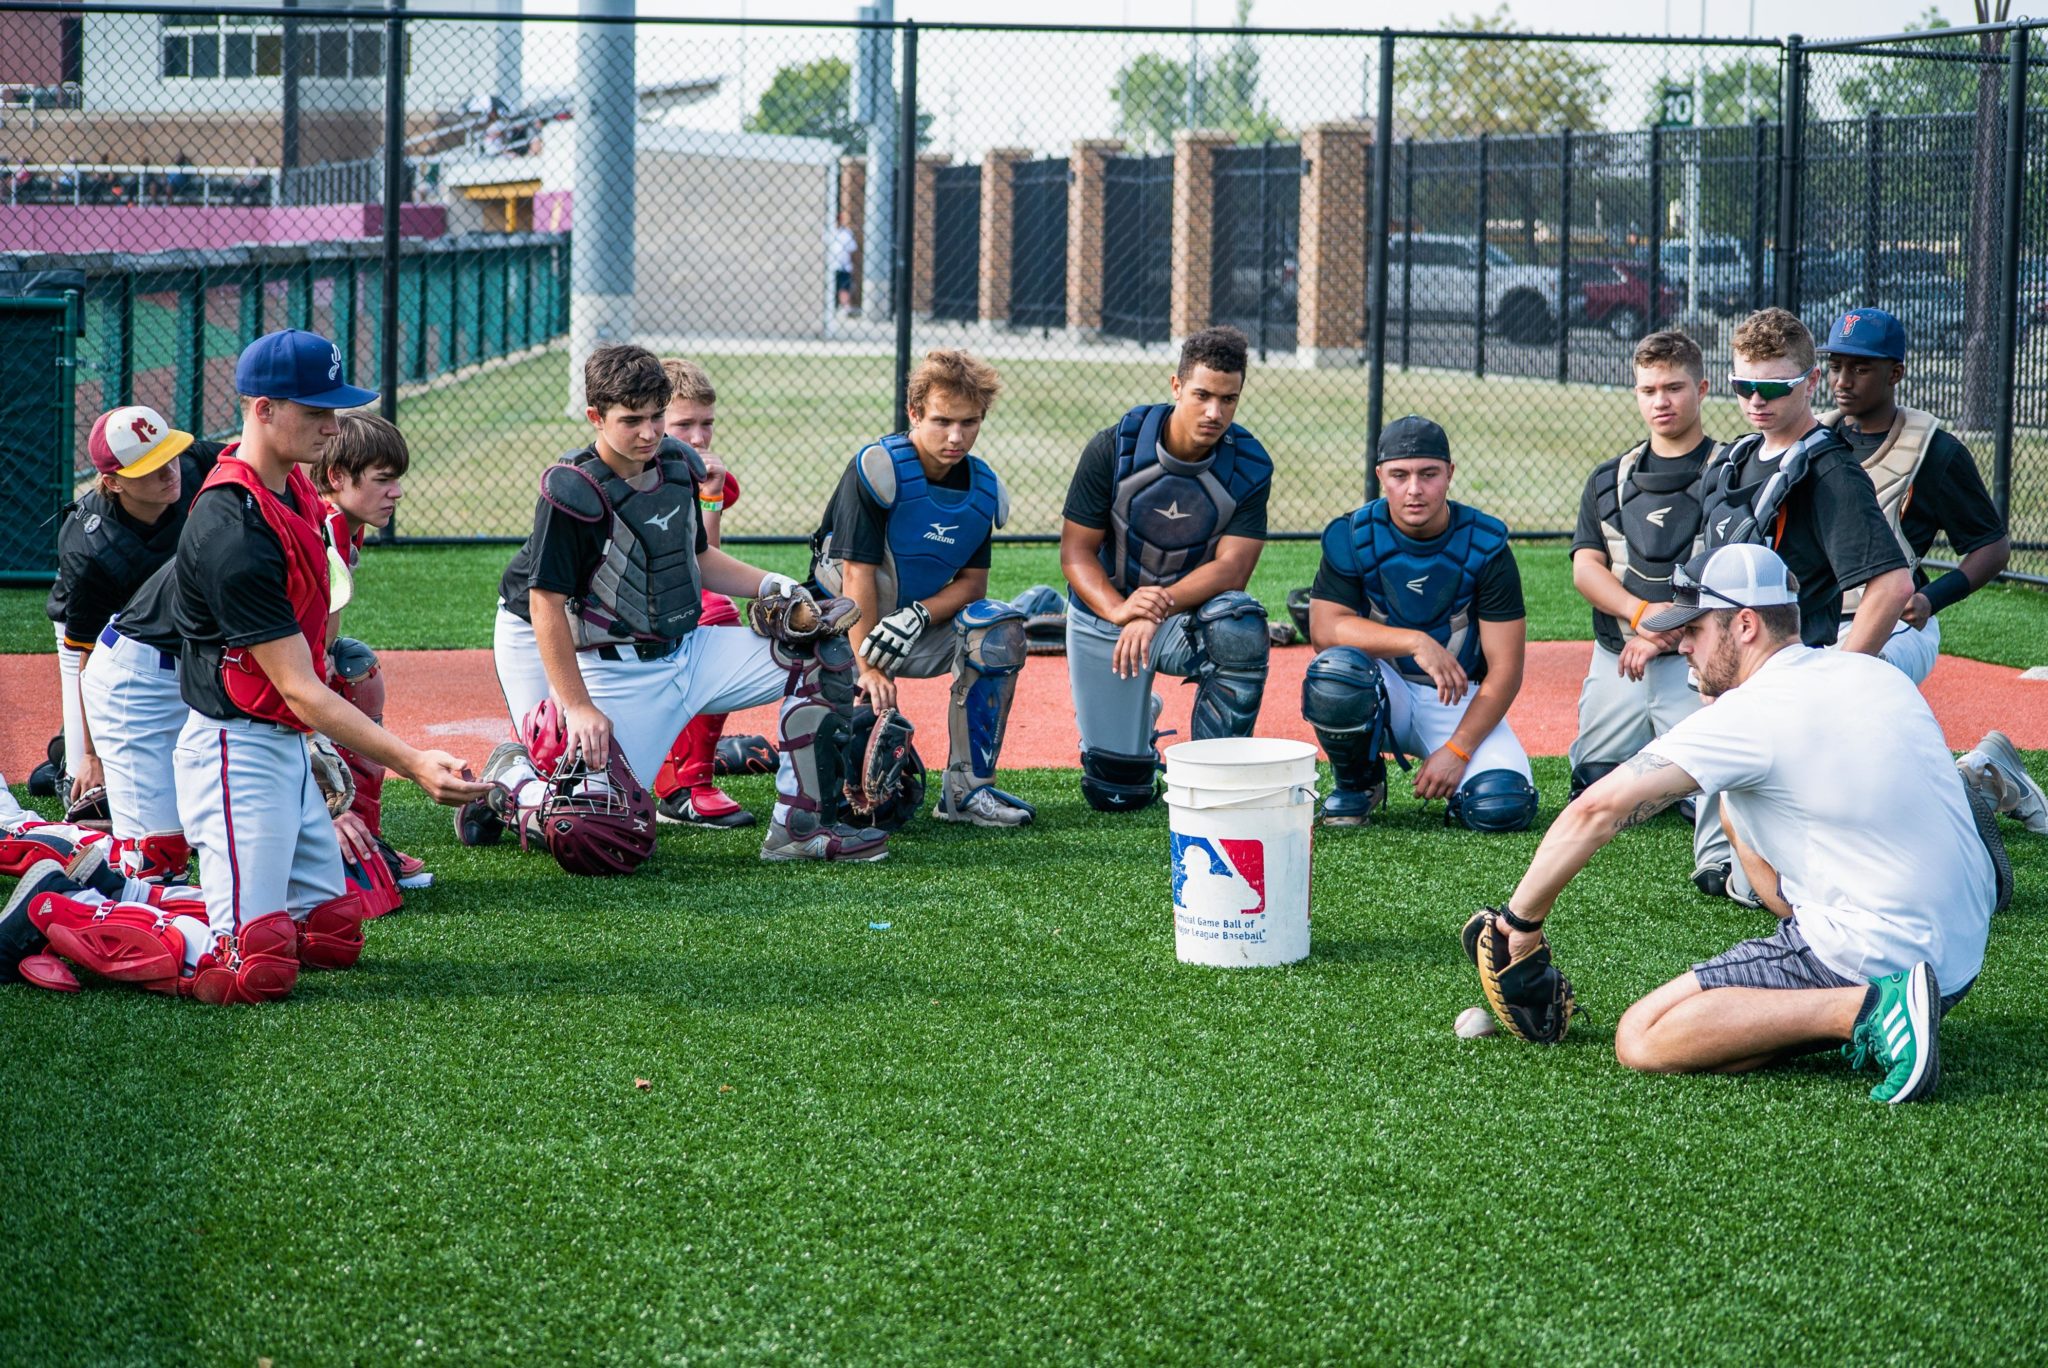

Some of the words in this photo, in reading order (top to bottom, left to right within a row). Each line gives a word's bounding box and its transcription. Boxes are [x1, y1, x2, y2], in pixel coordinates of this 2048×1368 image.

[1197, 916, 1220, 928] Game
[1223, 919, 1241, 929] Ball
[1244, 919, 1256, 929] of
[1177, 924, 1190, 936] ajor
[1192, 927, 1220, 941] League
[1222, 930, 1264, 940] Baseball
